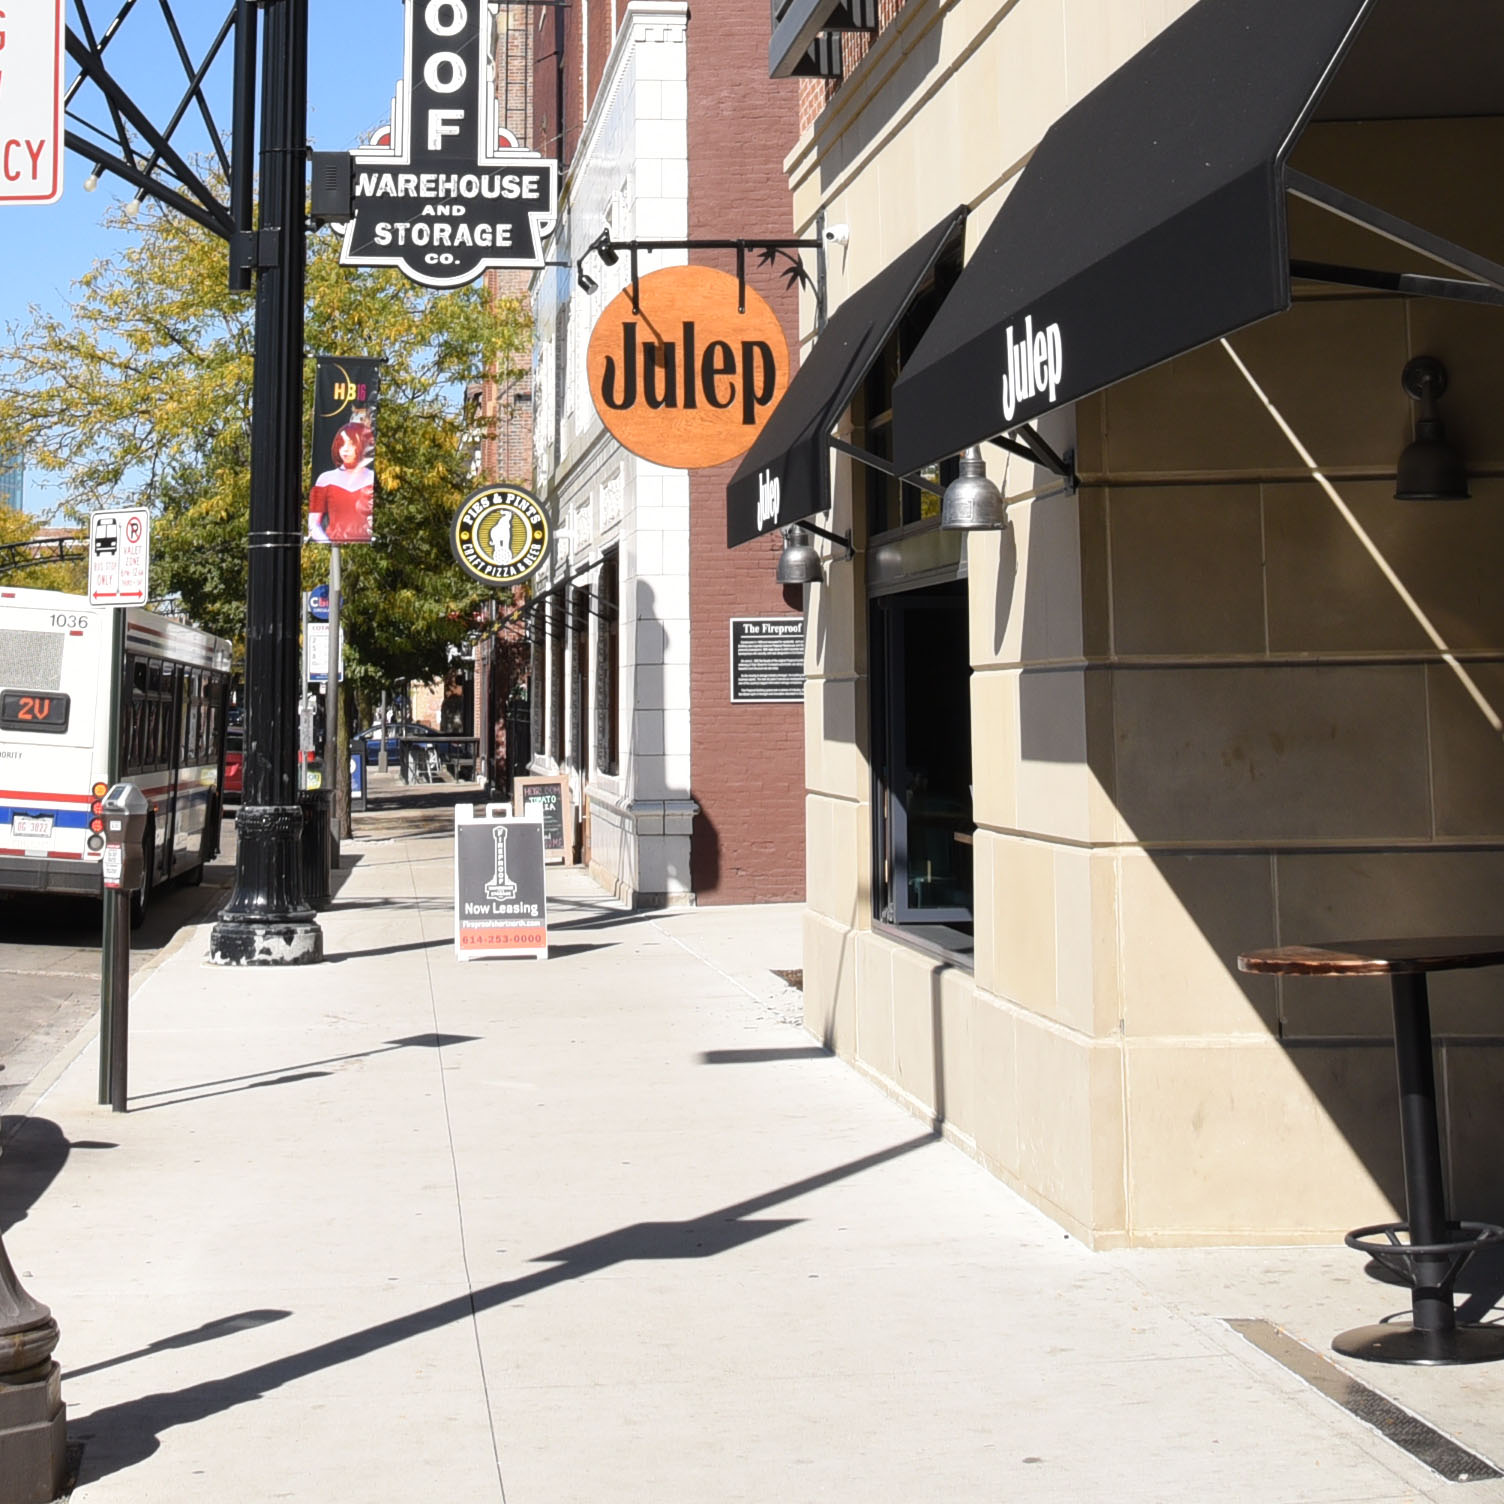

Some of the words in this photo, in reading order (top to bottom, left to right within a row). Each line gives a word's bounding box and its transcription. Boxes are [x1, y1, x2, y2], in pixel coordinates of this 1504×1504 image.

[355, 173, 539, 199] WAREHOUSE
[422, 204, 466, 216] AND
[373, 222, 514, 247] STORAGE
[424, 253, 461, 264] CO.
[601, 320, 777, 425] Julep
[1002, 314, 1063, 422] Julep
[463, 496, 490, 525] PIES
[493, 492, 502, 504] &
[505, 493, 542, 525] PINTS
[756, 468, 781, 532] Julep
[462, 543, 486, 570] CRAFT
[484, 565, 517, 577] PIZZA
[517, 562, 526, 572] &
[523, 544, 542, 566] BEER
[97, 574, 112, 586] ONLY
[50, 614, 88, 628] 1036
[743, 623, 760, 634] The
[762, 622, 803, 636] Fireproof
[18, 696, 50, 720] 2V
[464, 902, 490, 915] Now
[492, 901, 539, 916] Leasing
